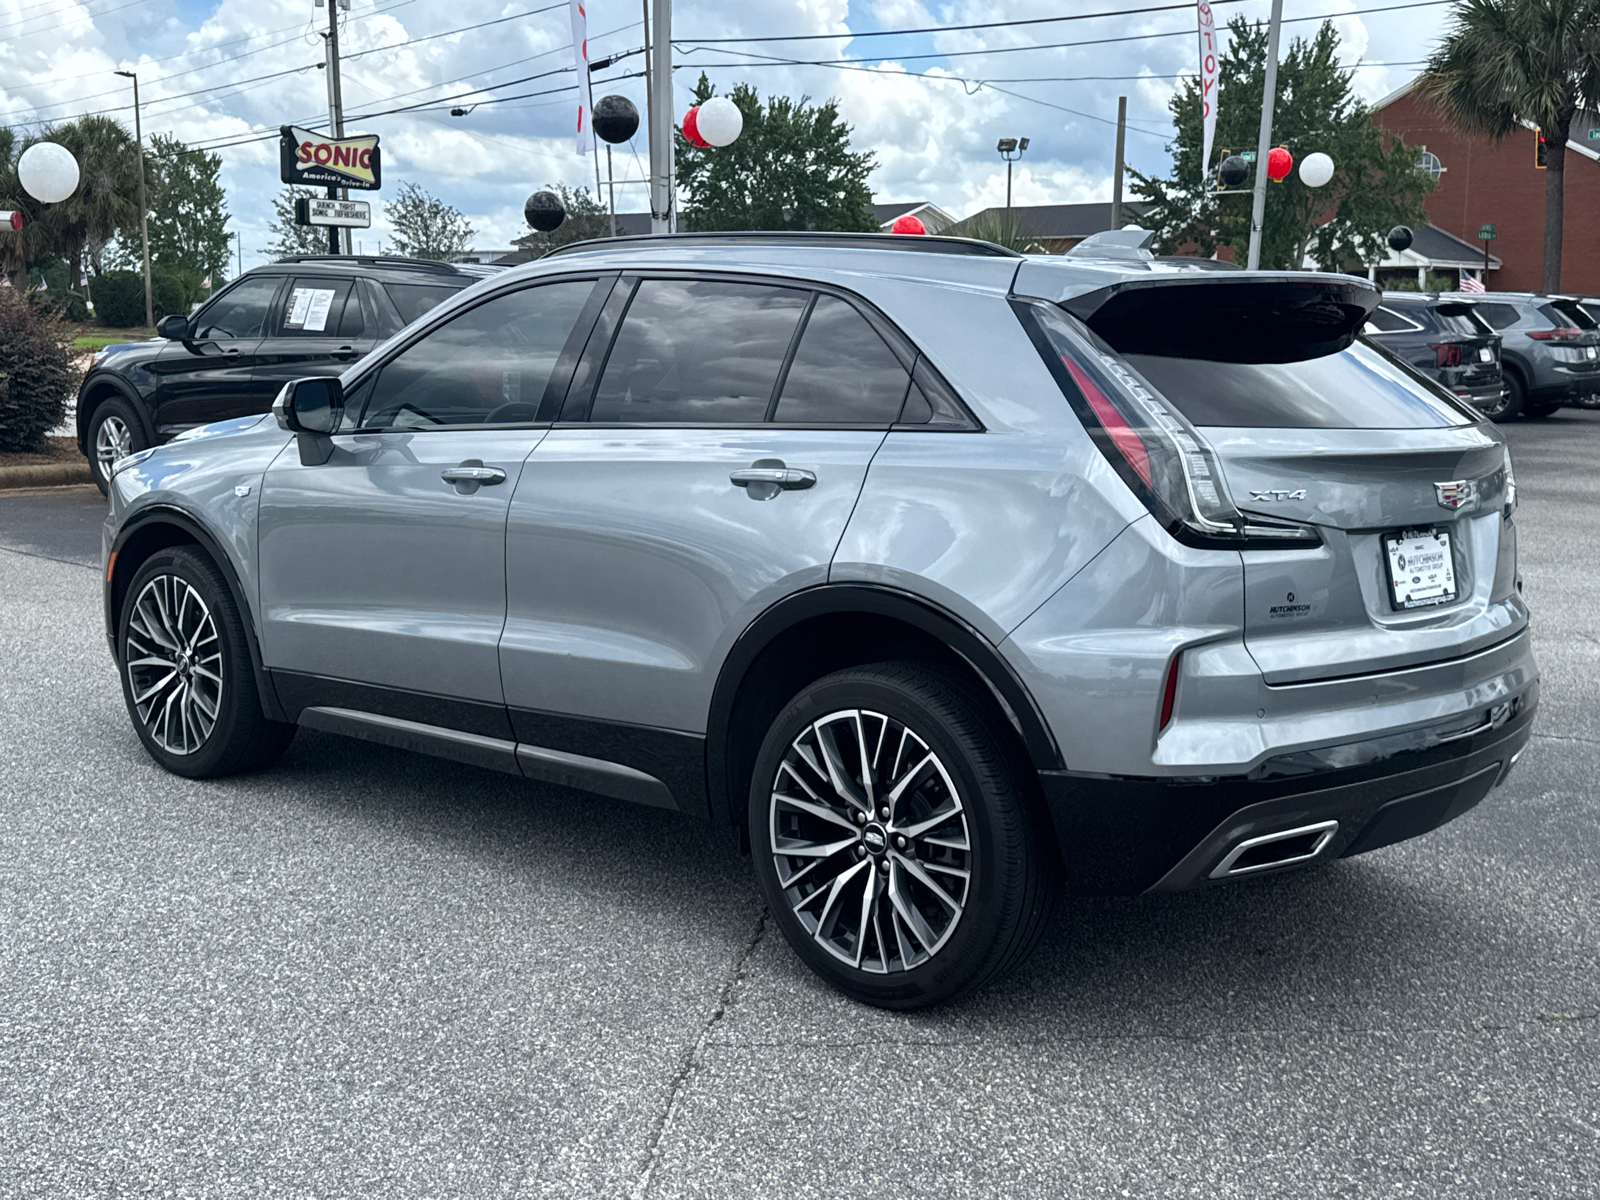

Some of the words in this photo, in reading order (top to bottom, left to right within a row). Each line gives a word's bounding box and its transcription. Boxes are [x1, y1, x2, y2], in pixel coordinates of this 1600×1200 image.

[300, 141, 373, 169] SONIC
[302, 172, 341, 182] America's
[341, 180, 371, 188] Drive-In
[1249, 489, 1307, 501] XT4
[1270, 604, 1311, 613] HUTCHINSON
